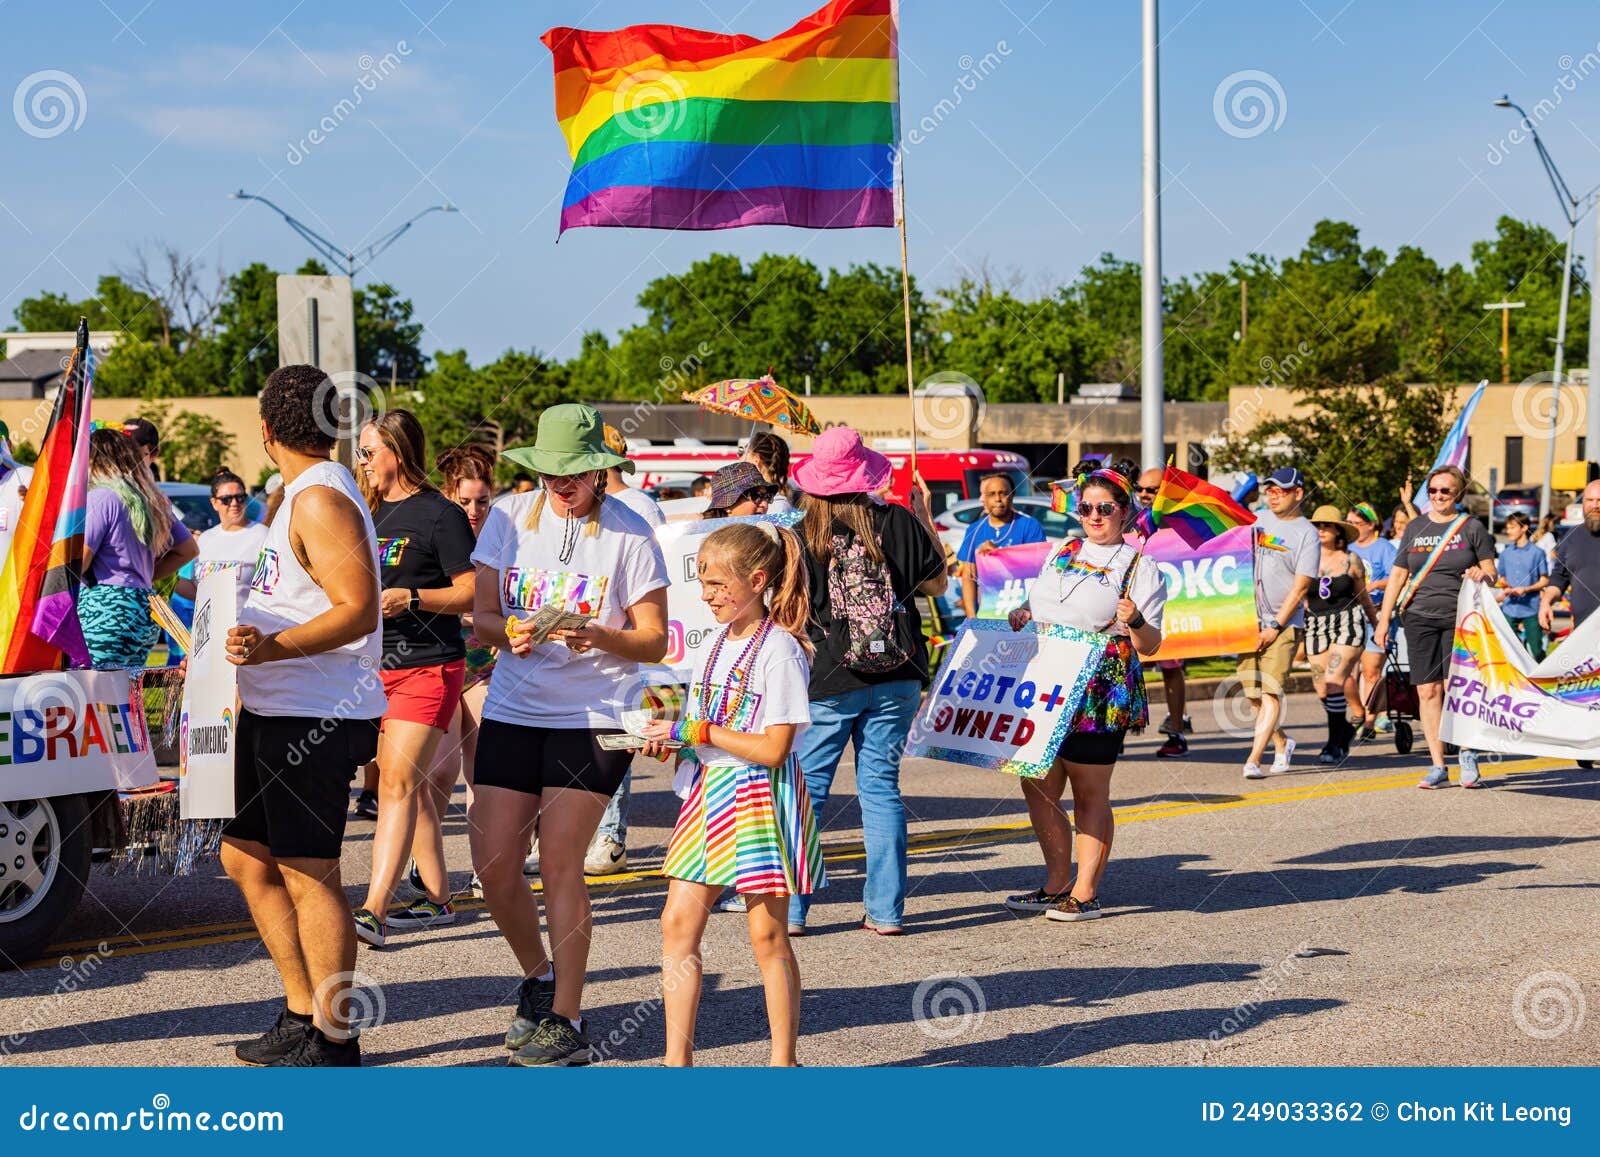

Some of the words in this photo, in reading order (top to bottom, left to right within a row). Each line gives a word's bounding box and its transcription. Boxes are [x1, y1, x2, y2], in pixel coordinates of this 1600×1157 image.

[939, 669, 1065, 712] LGBTQ+
[1447, 675, 1541, 718] PFLAG
[933, 705, 1036, 747] OWNED
[1446, 696, 1524, 733] NORMAN
